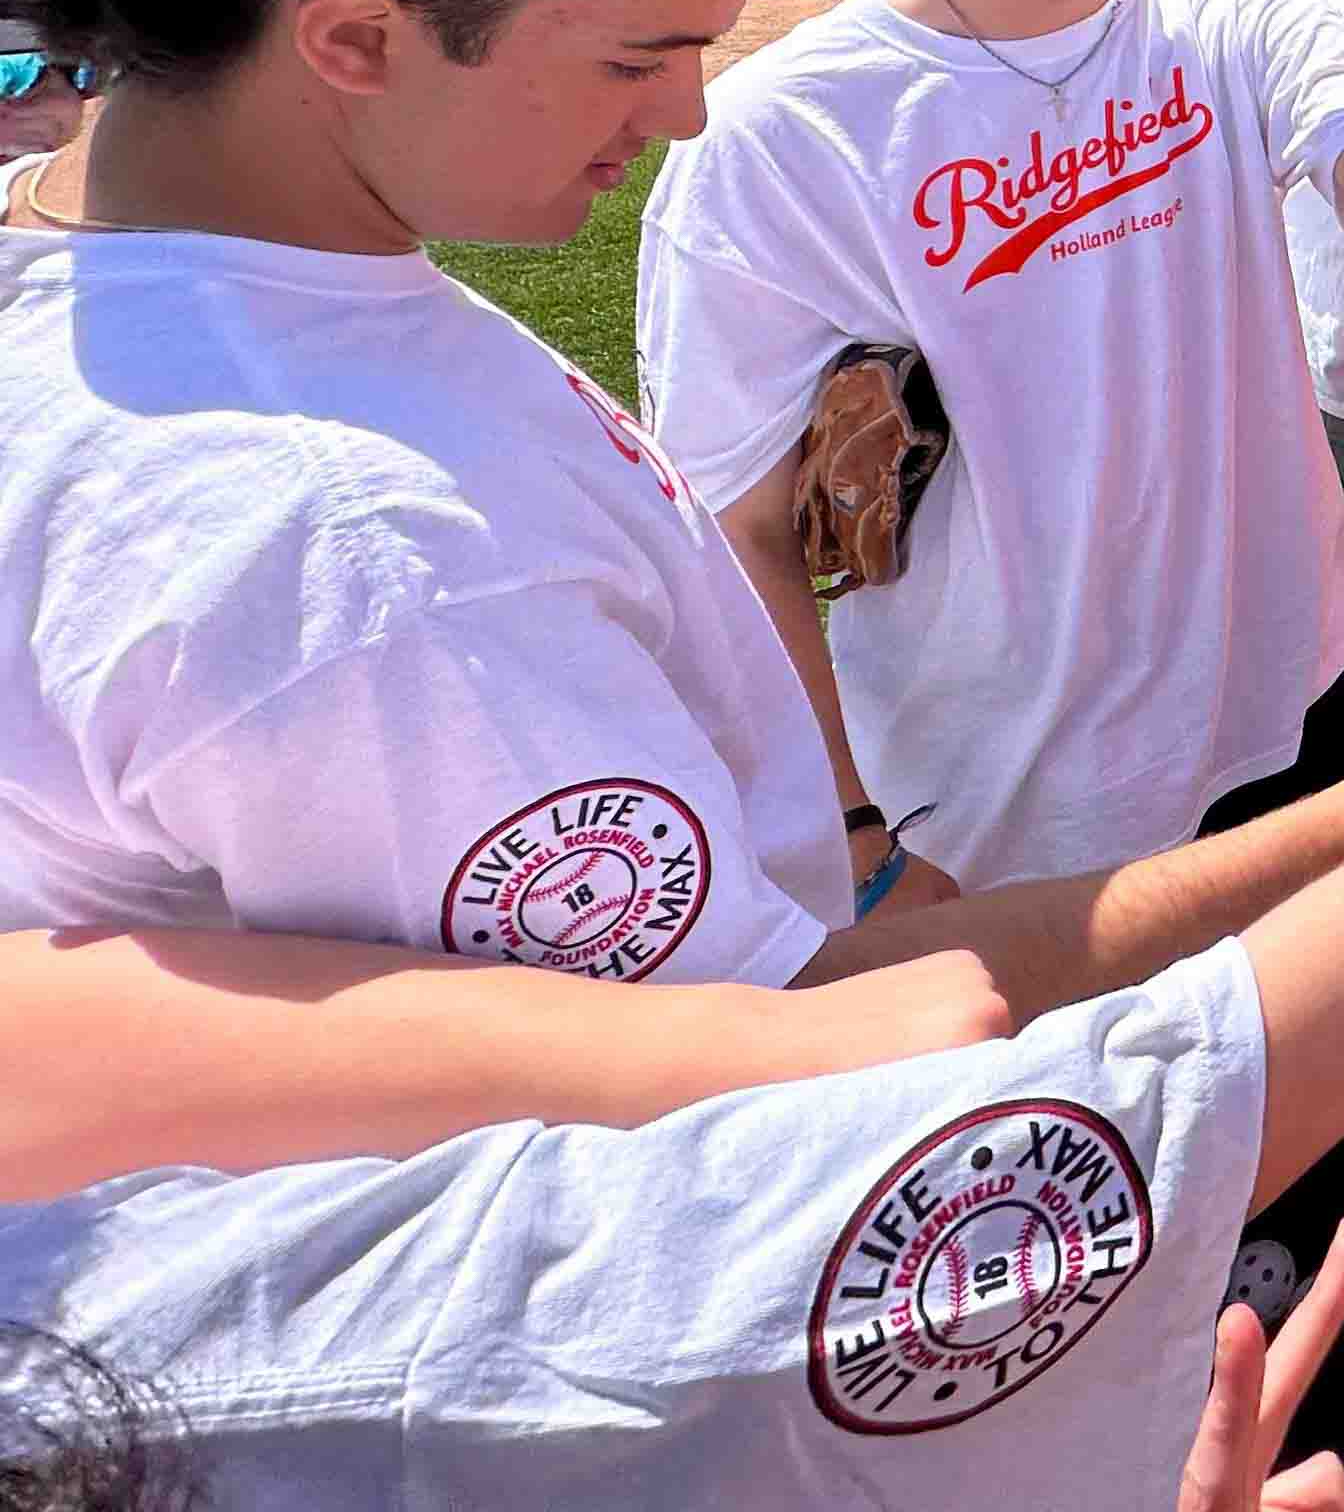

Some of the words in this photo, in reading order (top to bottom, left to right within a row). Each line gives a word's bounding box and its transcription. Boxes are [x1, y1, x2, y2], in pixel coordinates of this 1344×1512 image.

[1050, 218, 1127, 263] Holland
[1131, 197, 1184, 234] Leage
[461, 828, 541, 906] LIVE
[551, 794, 645, 837] LIFE
[497, 847, 560, 912] MICHAEL
[563, 828, 656, 870] ROSENFIELD
[538, 887, 657, 966] FOUNDATION
[560, 882, 596, 914] 18
[587, 933, 657, 979] HE
[643, 843, 696, 932] MAX
[1015, 1120, 1116, 1204] MAX
[839, 1168, 943, 1300] LIFE
[894, 1174, 1017, 1289] ROSENFIELD
[1029, 1180, 1089, 1330] FOUNDATION
[1061, 1191, 1134, 1313] THE
[973, 1255, 1010, 1300] 18
[834, 1319, 917, 1413] LIVE
[888, 1297, 943, 1370] MICHAEL
[941, 1345, 998, 1371] MAX
[983, 1320, 1066, 1389] TO
